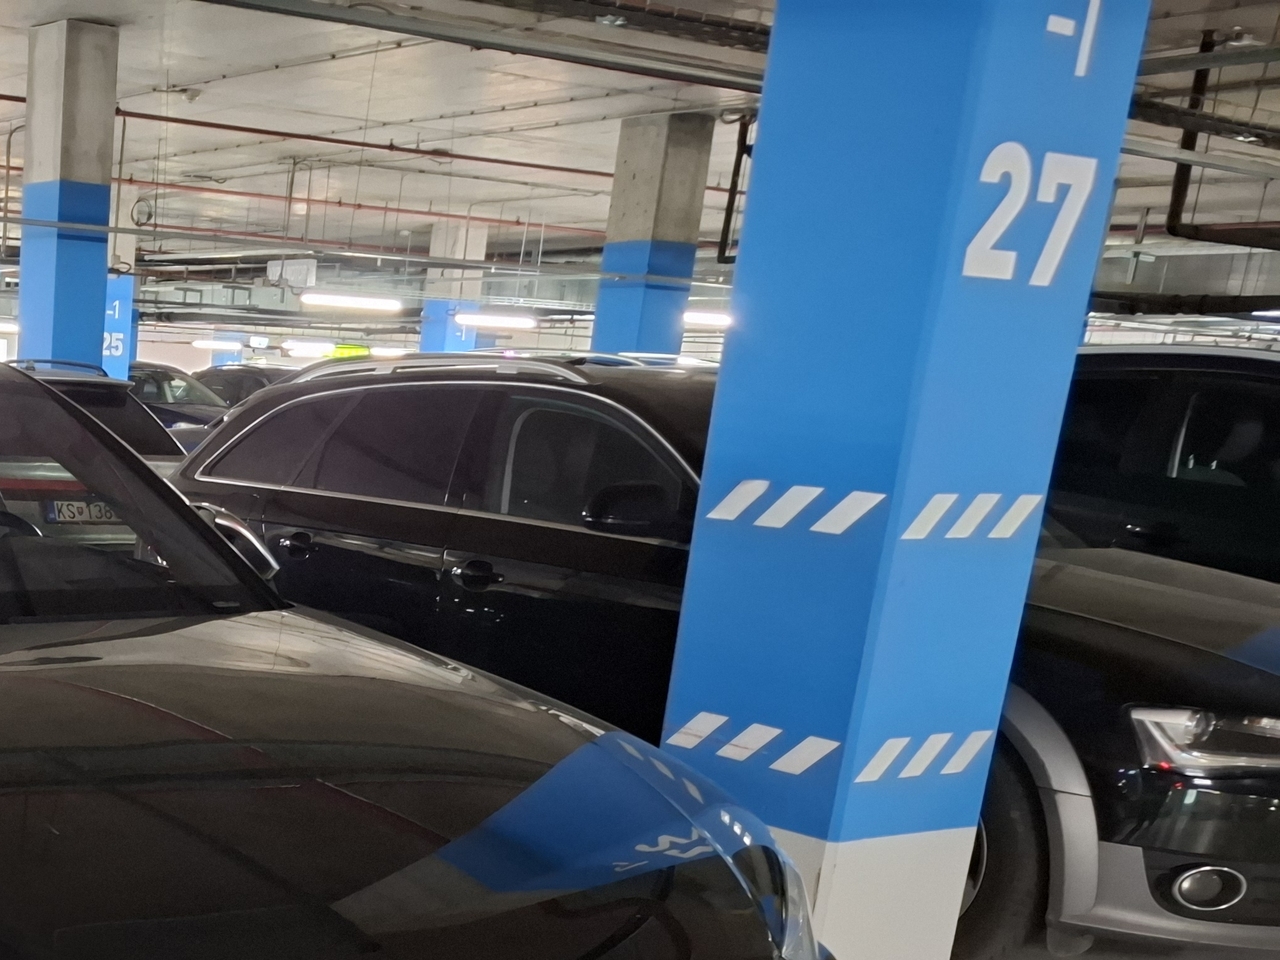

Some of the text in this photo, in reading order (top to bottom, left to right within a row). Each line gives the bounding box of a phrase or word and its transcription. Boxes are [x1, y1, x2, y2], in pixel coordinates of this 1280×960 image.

[962, 141, 1098, 287] 27
[106, 300, 120, 319] -1
[102, 332, 124, 357] 25
[55, 503, 76, 519] KS
